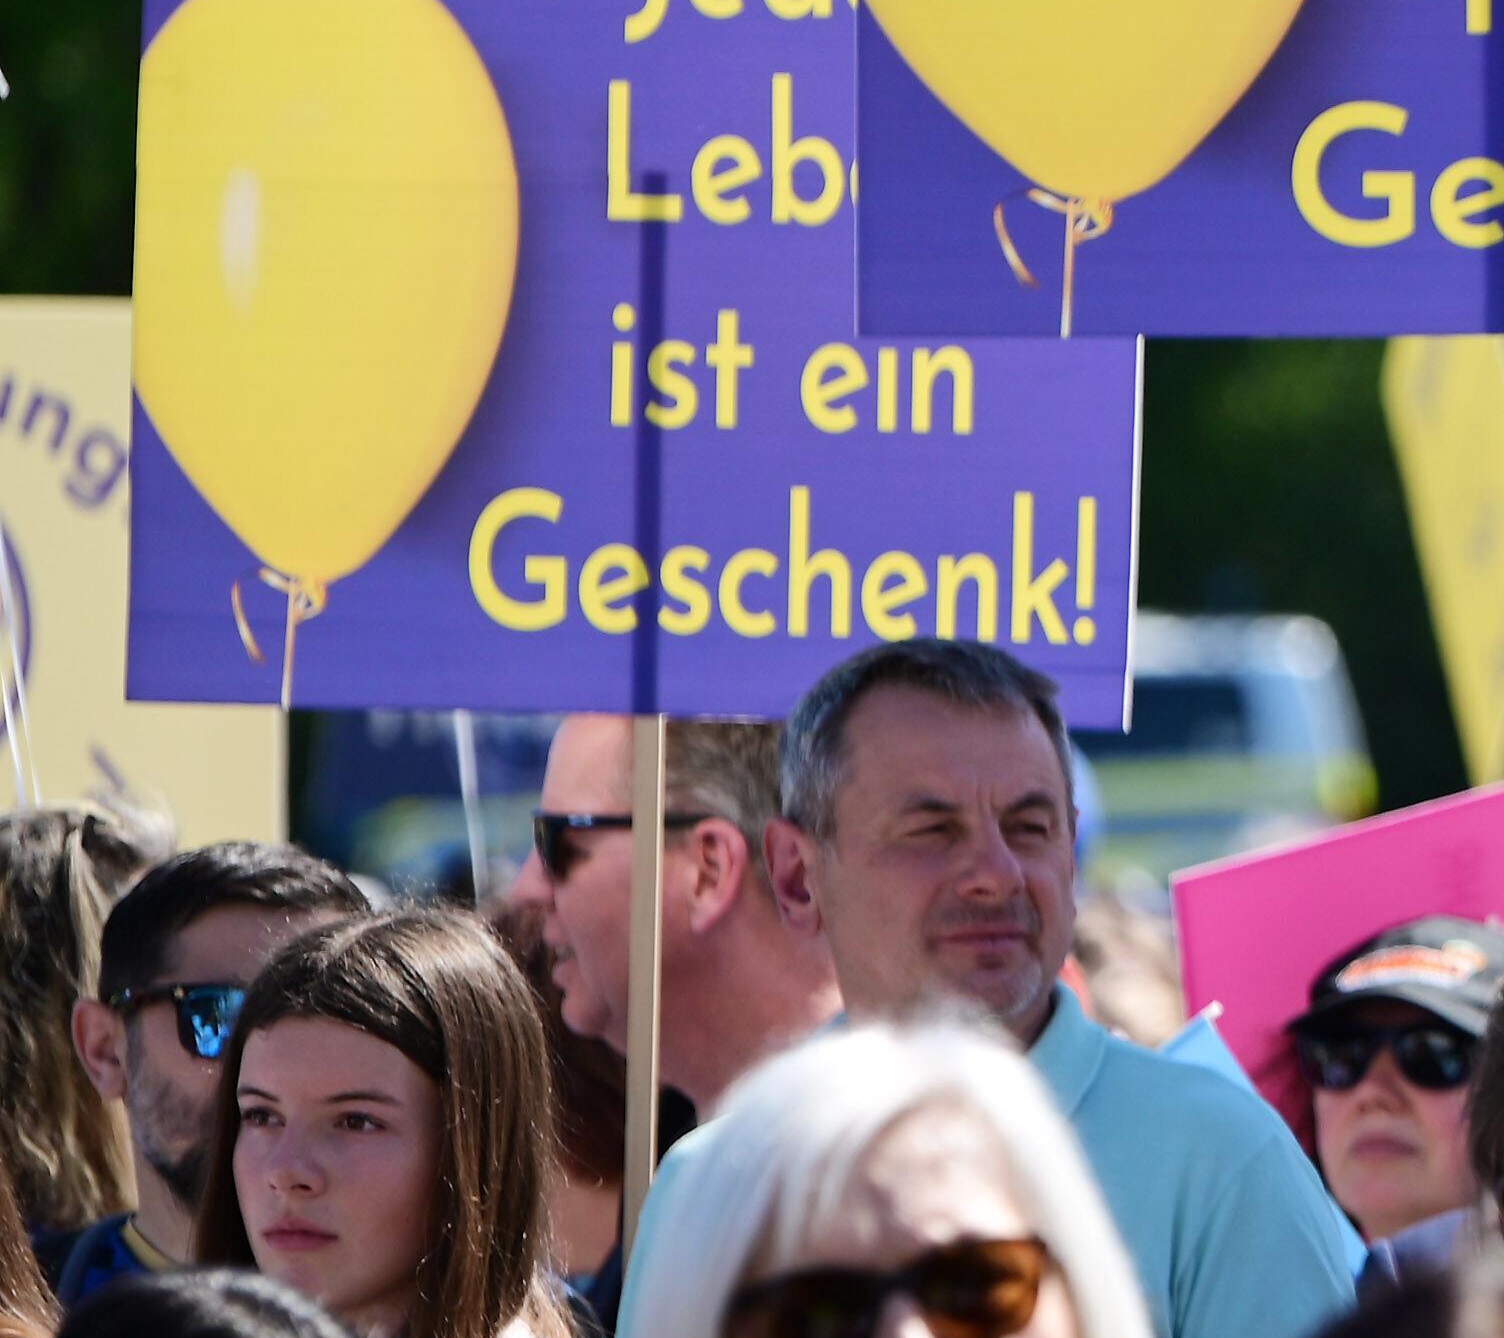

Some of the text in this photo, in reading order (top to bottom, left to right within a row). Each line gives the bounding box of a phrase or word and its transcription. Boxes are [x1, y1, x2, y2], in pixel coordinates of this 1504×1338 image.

[606, 72, 857, 227] Leb
[610, 303, 976, 435] ist ein
[466, 485, 1098, 646] Geschenk!
